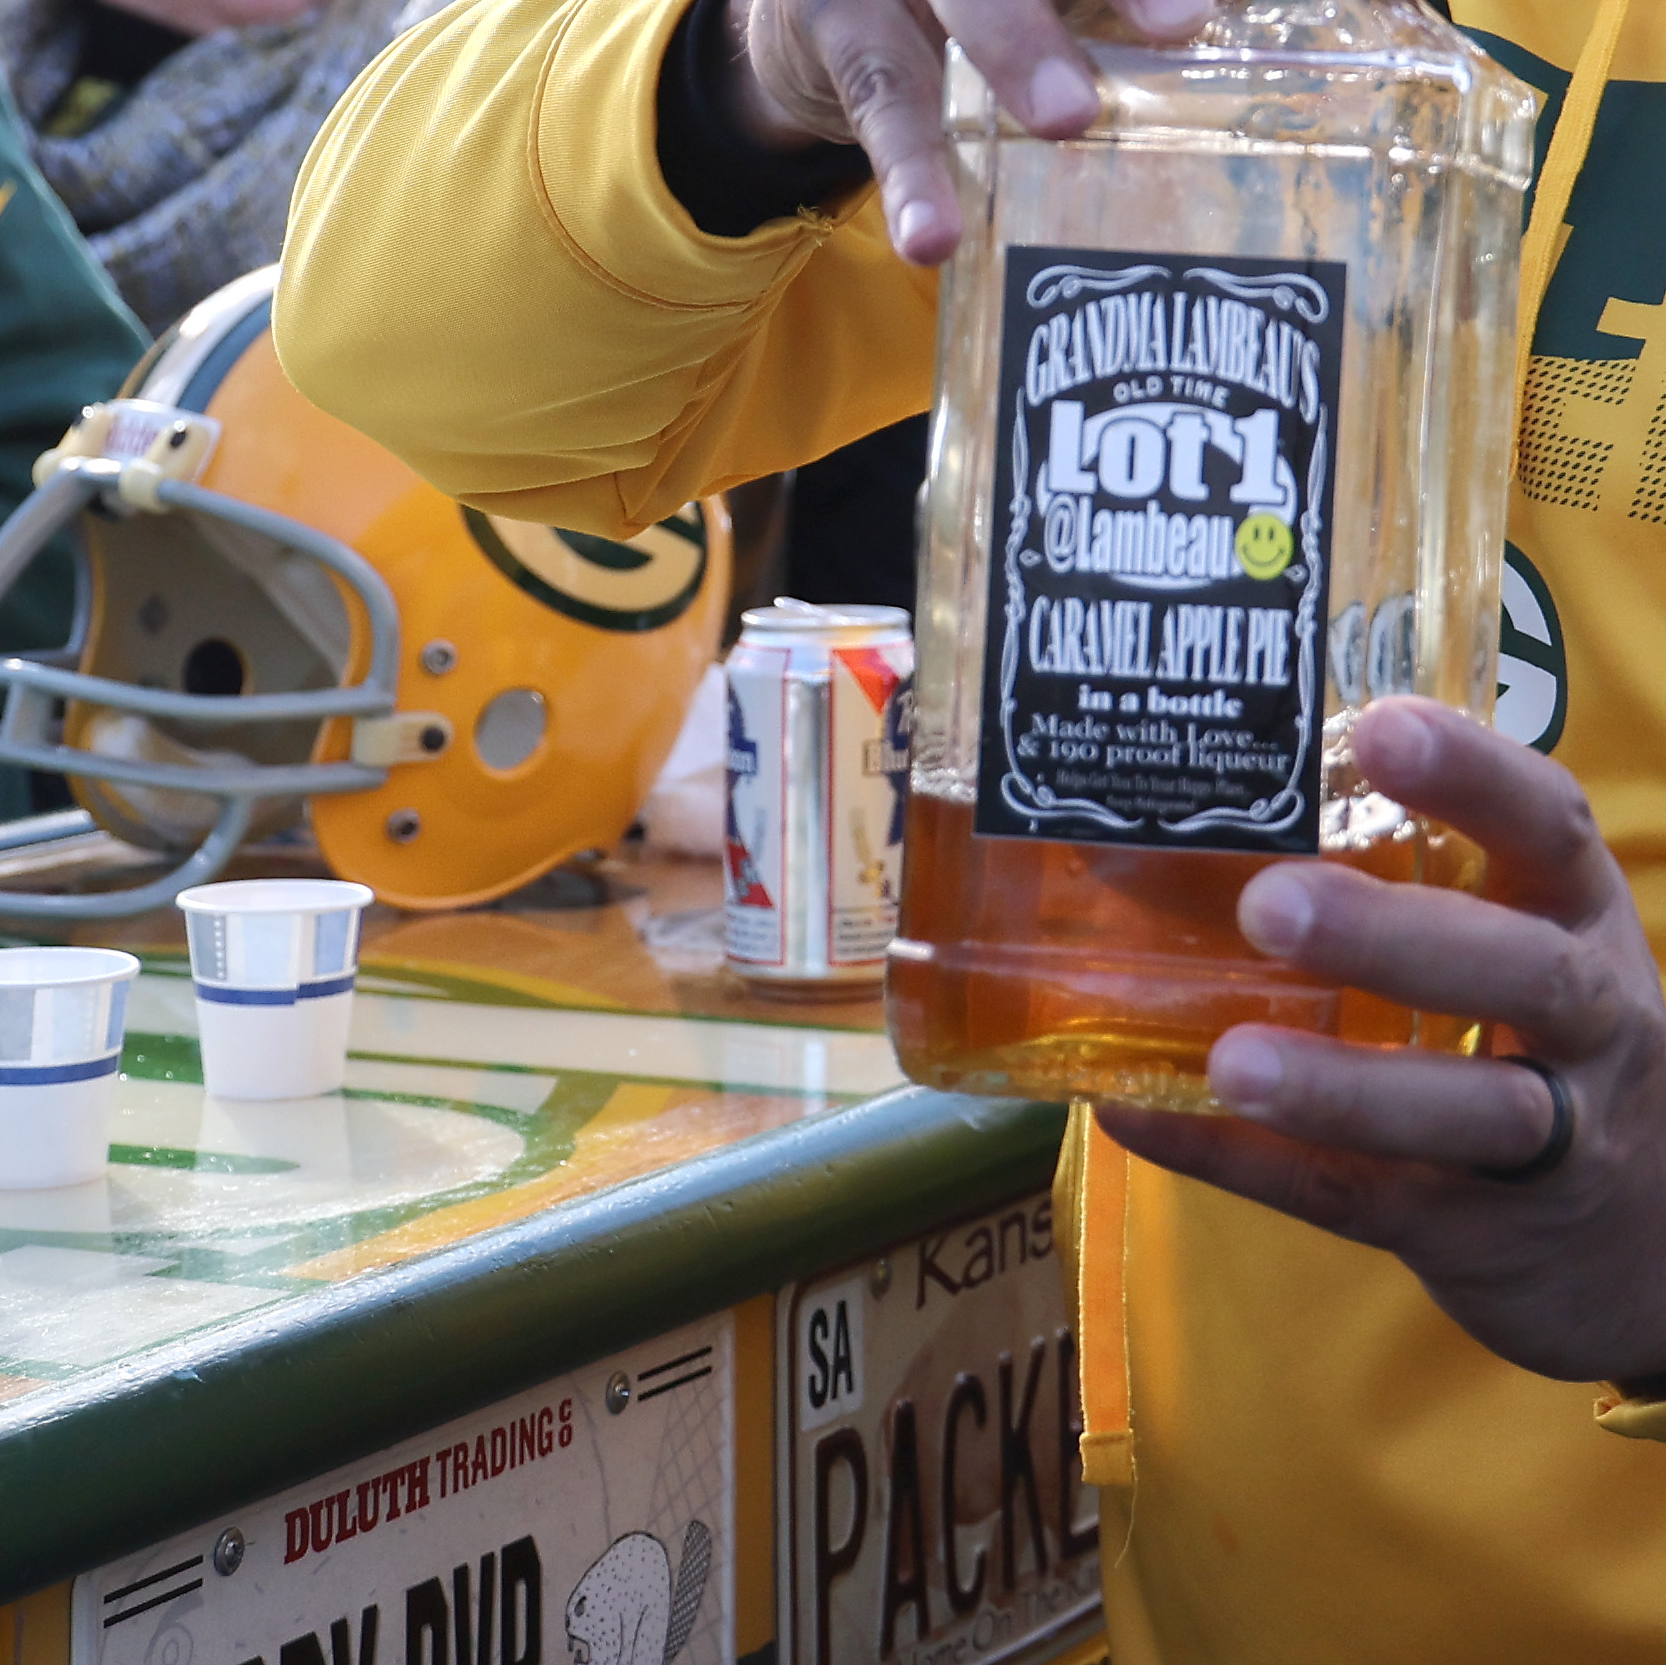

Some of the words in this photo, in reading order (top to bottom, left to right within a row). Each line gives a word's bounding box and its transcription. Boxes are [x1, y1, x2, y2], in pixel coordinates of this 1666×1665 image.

[1026, 290, 1169, 407] GRANDMA
[1170, 291, 1321, 424] LAMBEAU'S
[1113, 375, 1164, 403] OLD
[1170, 375, 1230, 409] TIME
[1047, 399, 1211, 502] Lot
[1229, 408, 1286, 504] 1
[1044, 494, 1234, 580] @Lambeau
[1028, 594, 1153, 678] CARAMEL
[1155, 603, 1245, 684] APPLE
[1244, 607, 1293, 685] PIE
[1032, 712, 1111, 741] Made
[1115, 718, 1178, 746] with
[1078, 684, 1112, 712] in
[1118, 691, 1141, 714] a
[1146, 684, 1244, 719] bottle
[1016, 734, 1040, 759] &
[1049, 737, 1101, 764] 190
[1105, 741, 1181, 769] proof
[1186, 740, 1290, 774] liqueur
[807, 1299, 853, 1409] SA
[284, 1456, 431, 1565] DULUTH
[436, 1406, 554, 1500] TRADING
